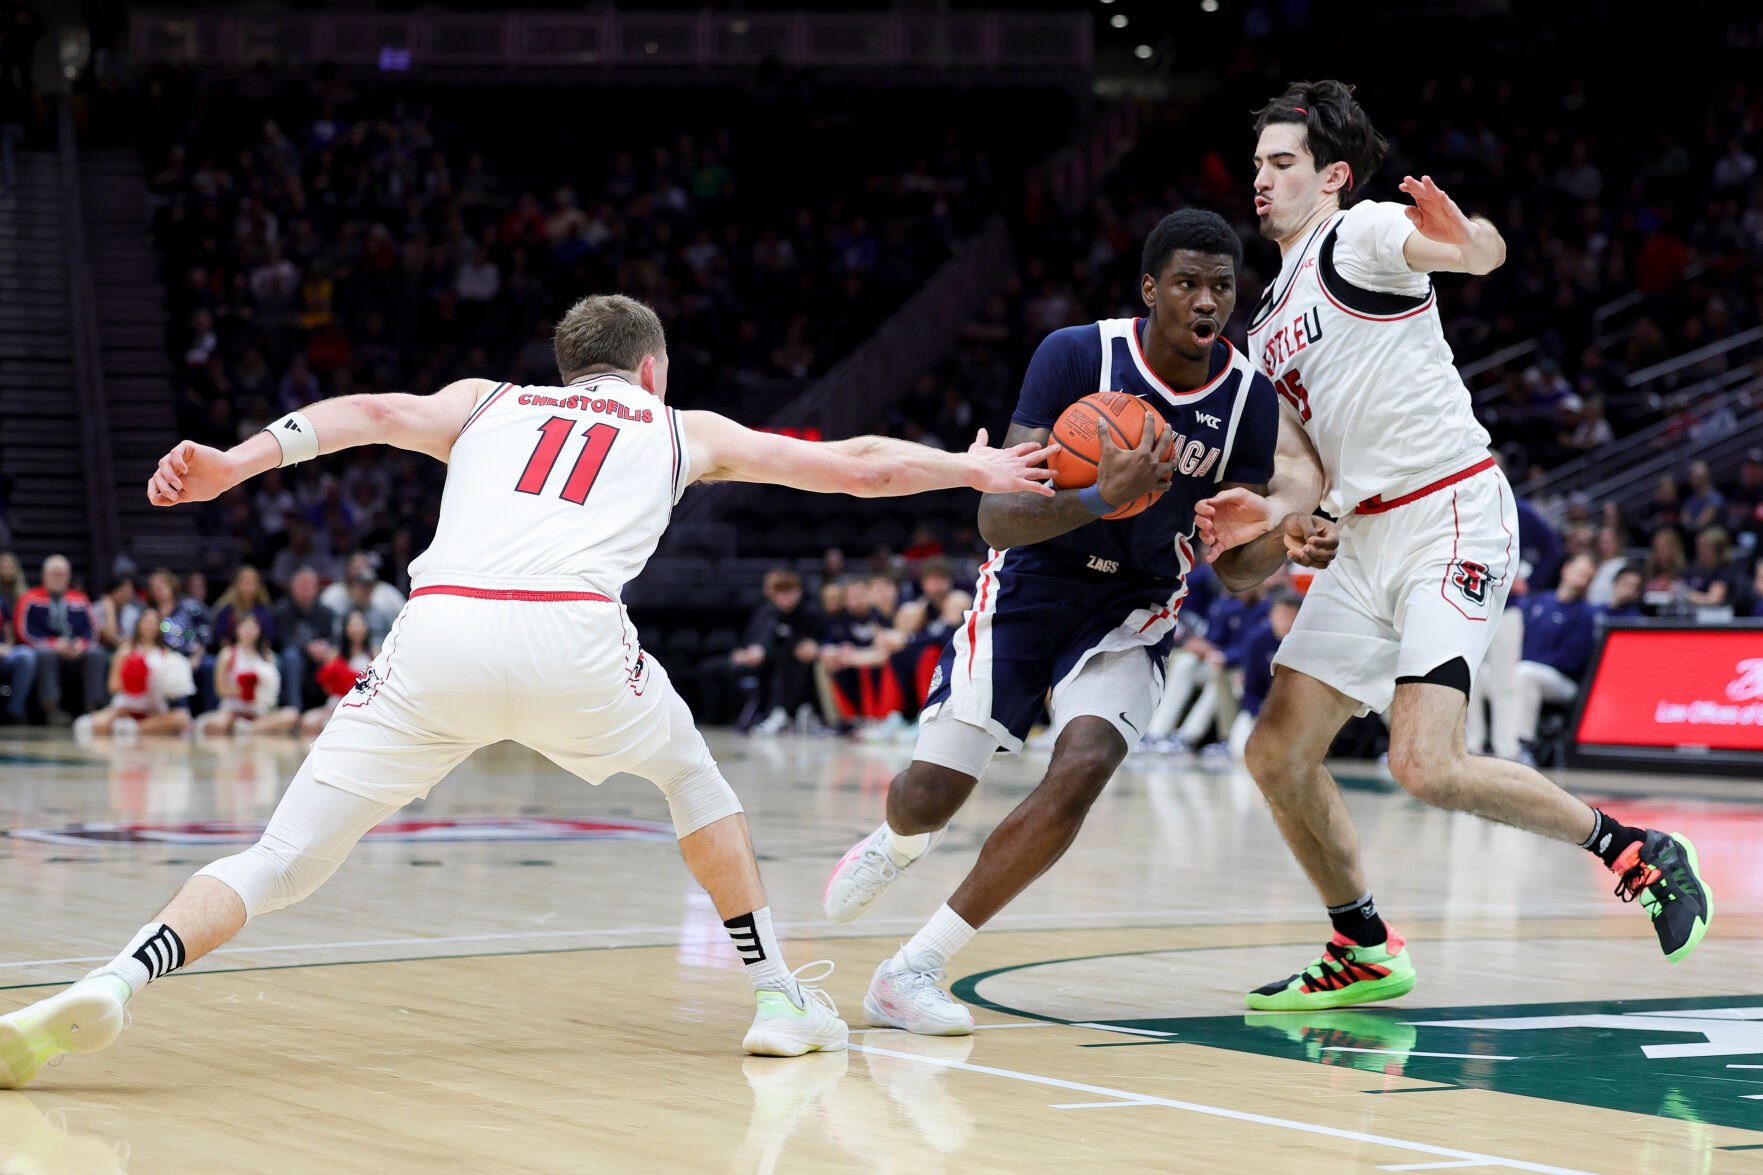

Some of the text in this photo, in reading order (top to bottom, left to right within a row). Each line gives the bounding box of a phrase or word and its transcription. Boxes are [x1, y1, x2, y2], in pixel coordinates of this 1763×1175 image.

[518, 393, 654, 424] CHRISTOFILIS
[1274, 368, 1312, 426] 15
[1194, 410, 1222, 430] WCC
[514, 415, 621, 506] 11
[1086, 554, 1120, 574] ZAGS
